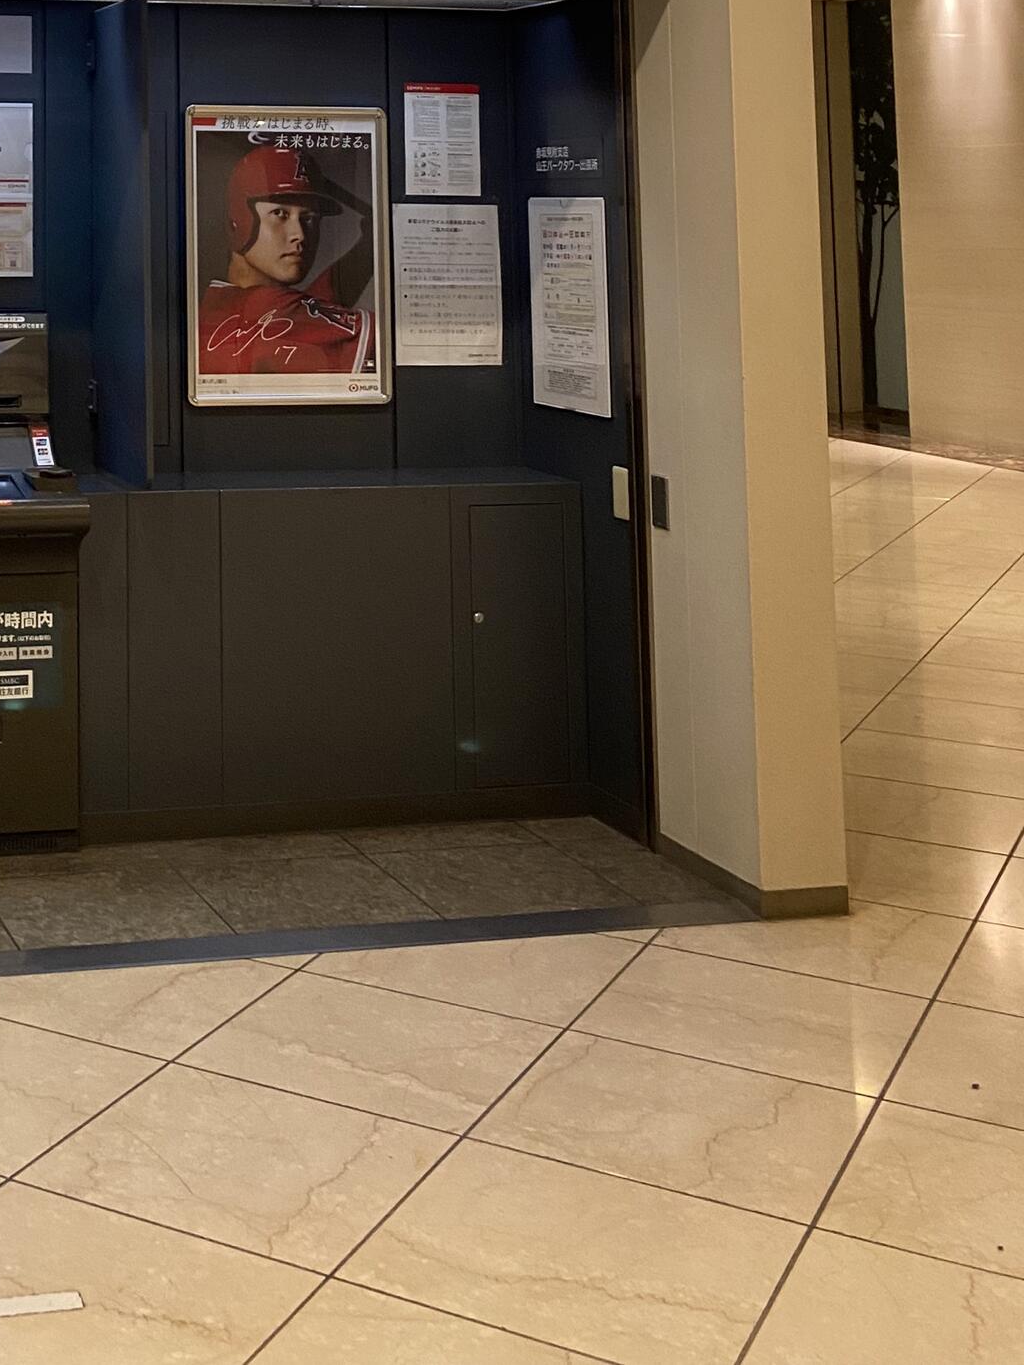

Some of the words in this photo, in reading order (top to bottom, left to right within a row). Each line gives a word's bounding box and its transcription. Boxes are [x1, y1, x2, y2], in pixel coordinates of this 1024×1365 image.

[221, 116, 335, 131] 挑戦がはじまる時、
[274, 133, 370, 150] 未来もはじまる。
[274, 345, 299, 365] 17
